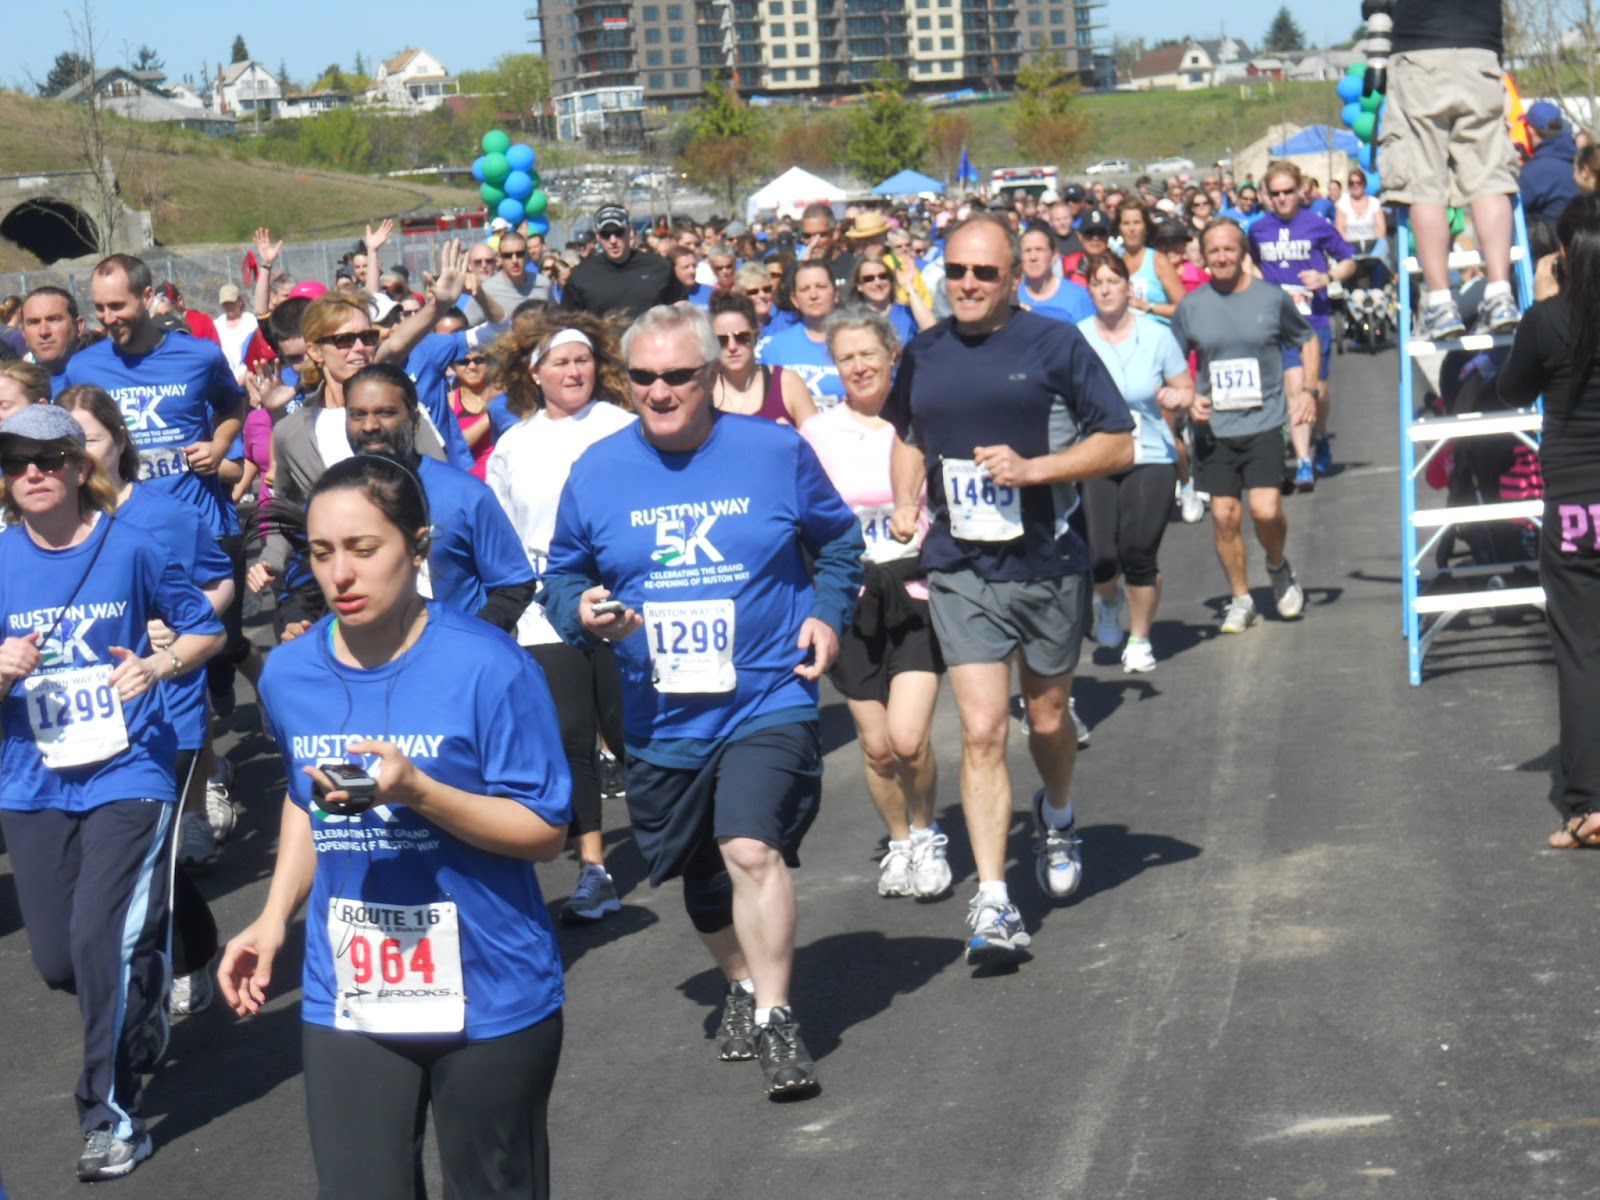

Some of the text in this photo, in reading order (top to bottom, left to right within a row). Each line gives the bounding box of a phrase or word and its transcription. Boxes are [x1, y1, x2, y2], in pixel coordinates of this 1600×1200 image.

[1216, 369, 1254, 389] 1571
[107, 384, 187, 401] USTON WAY
[121, 396, 167, 431] 5K
[951, 476, 1014, 507] 1465
[631, 497, 750, 527] RUSTON WAY
[651, 515, 725, 567] 5K
[644, 571, 750, 589] RE-OPENING OF RUSTON WAY
[650, 563, 743, 579] CELEBRATING THE GRAND
[10, 601, 127, 629] RUSTON WAY
[649, 608, 687, 618] RUSTON
[35, 618, 99, 666] 5K
[653, 618, 728, 654] 1298
[72, 675, 92, 685] WAY
[36, 685, 114, 729] 1299
[394, 735, 445, 757] WAY
[313, 828, 429, 840] ELEBRATING THE GRAND
[417, 840, 440, 851] WAY
[342, 905, 440, 926] ROUTE 16
[350, 935, 435, 984] 964
[378, 988, 451, 998] BROOKS
